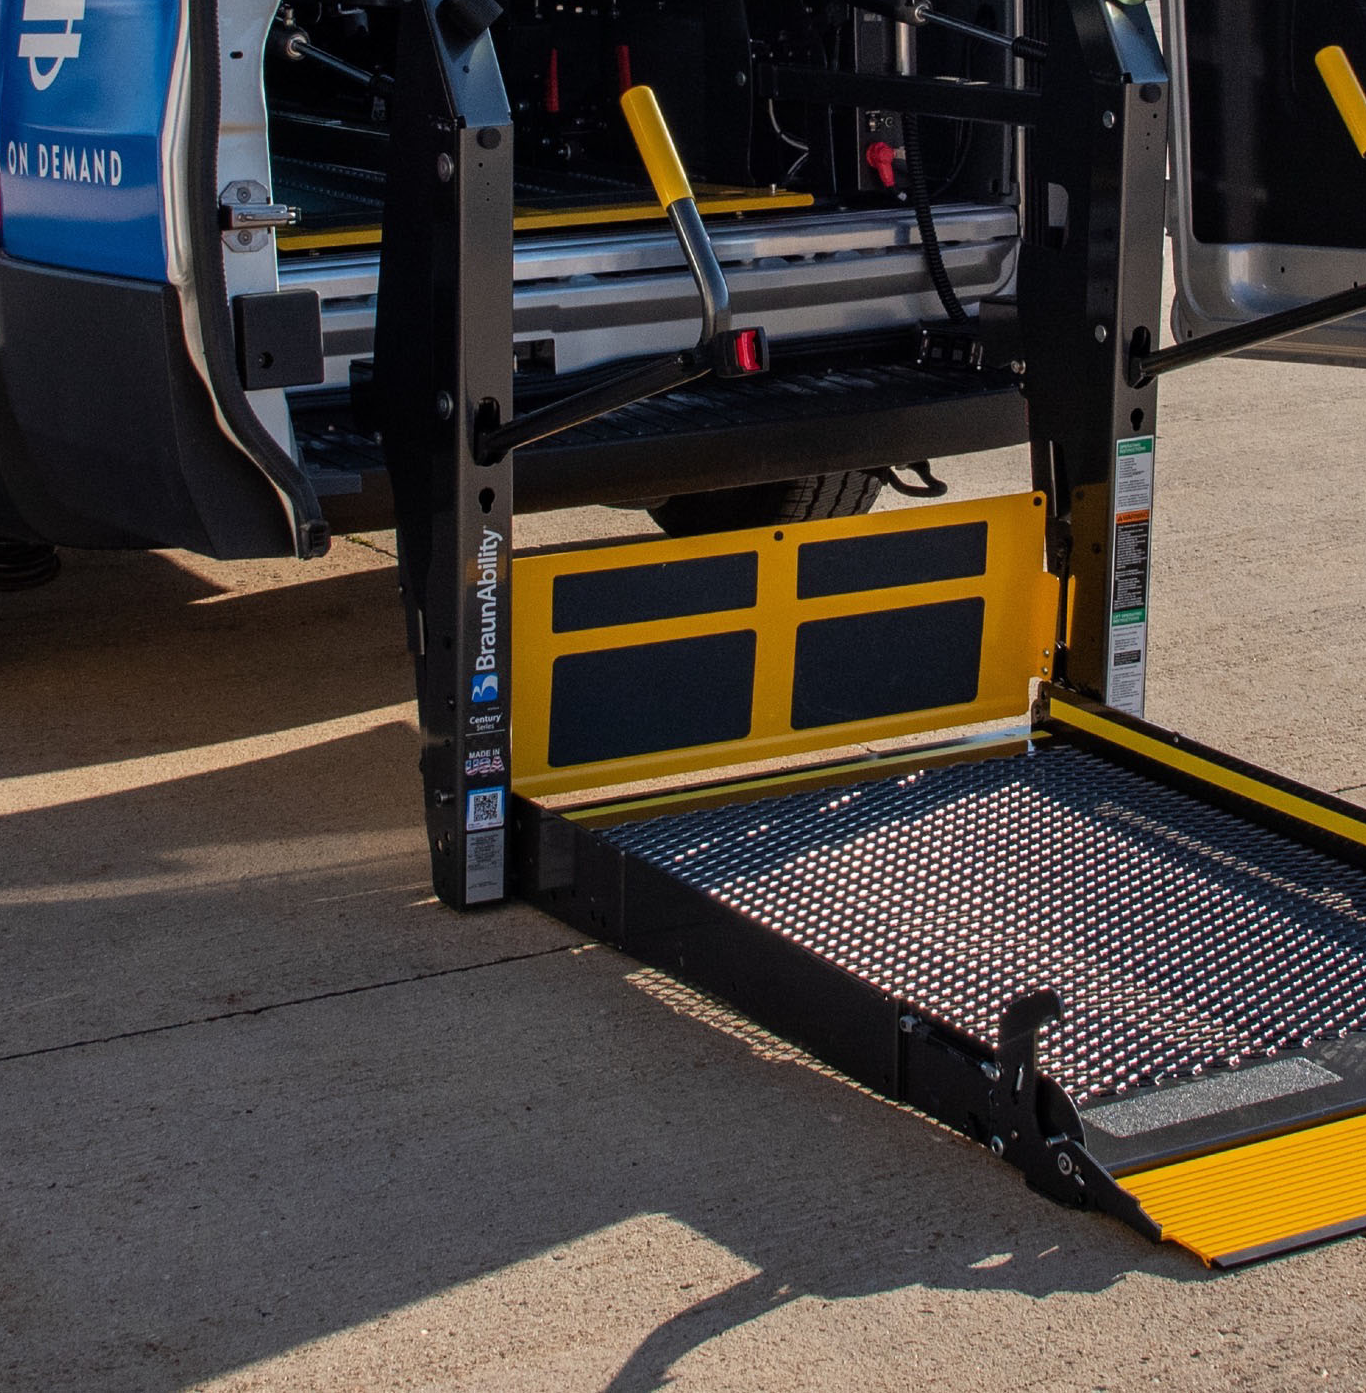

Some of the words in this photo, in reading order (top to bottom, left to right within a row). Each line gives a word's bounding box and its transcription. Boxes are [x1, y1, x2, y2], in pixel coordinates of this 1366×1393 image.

[8, 140, 29, 176] ON
[38, 143, 122, 186] DEMAND
[475, 529, 503, 671] BraunAbility
[469, 714, 501, 724] Century
[476, 723, 495, 732] Series
[469, 749, 491, 759] MADE
[492, 748, 501, 756] IN
[465, 755, 505, 776] USA
